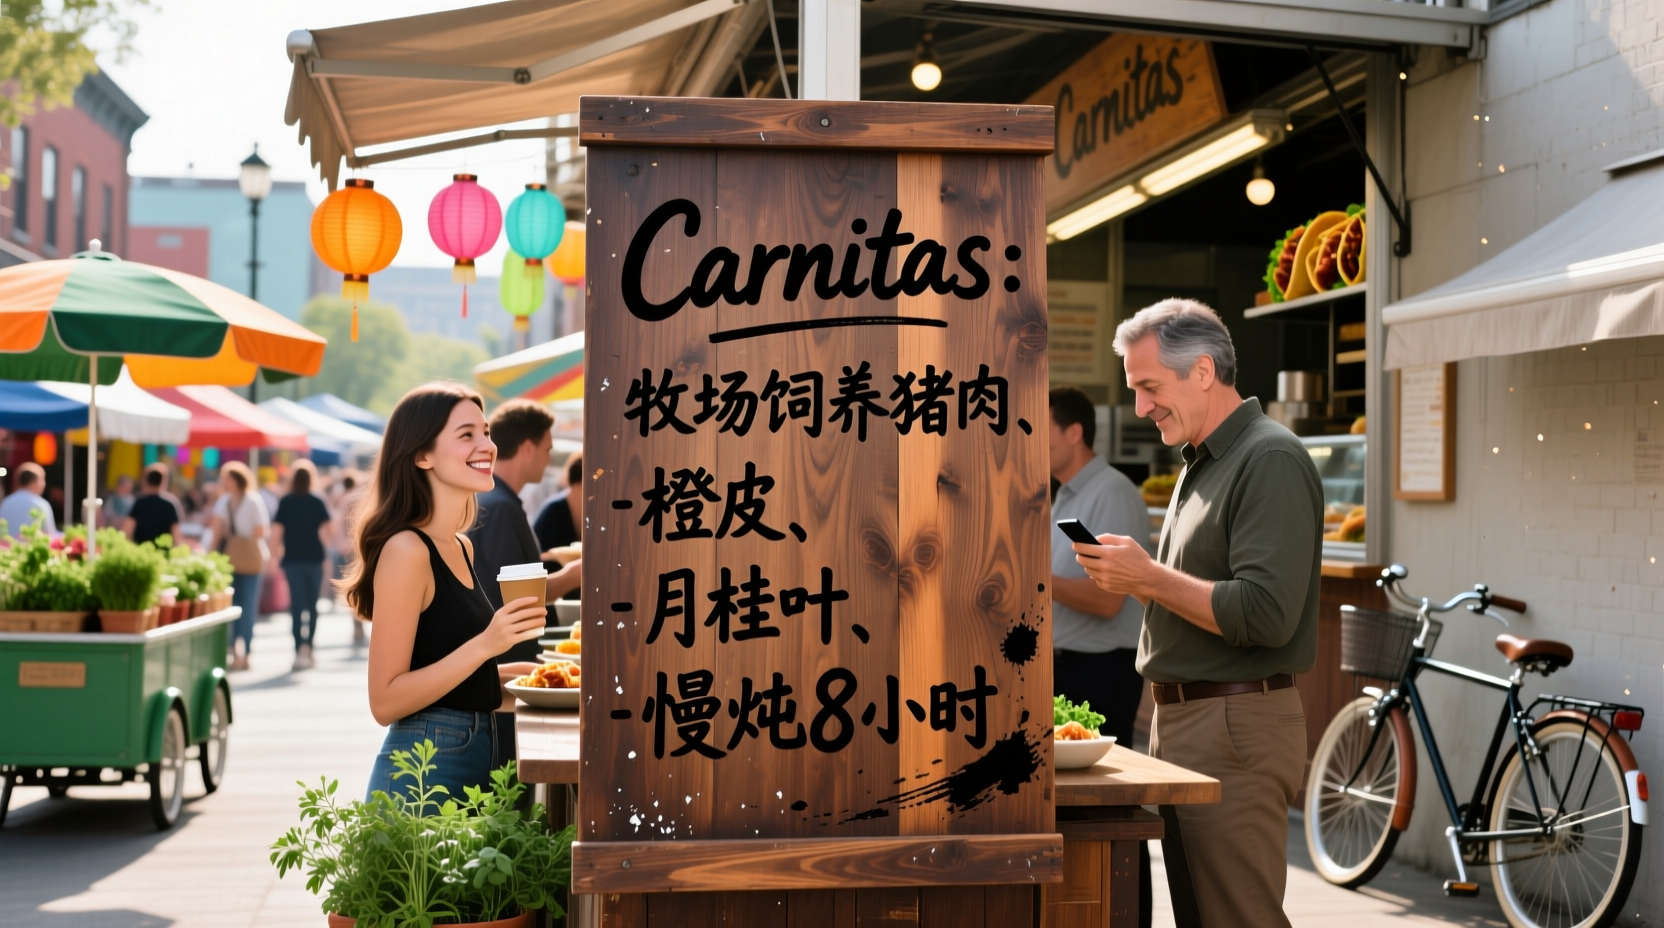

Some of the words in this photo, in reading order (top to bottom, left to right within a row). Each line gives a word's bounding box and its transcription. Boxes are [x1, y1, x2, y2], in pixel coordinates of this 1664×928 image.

[1055, 43, 1183, 179] Carnitas
[621, 198, 1022, 322] Carnitas:
[624, 360, 1033, 442] 牧场饲养猪肉、
